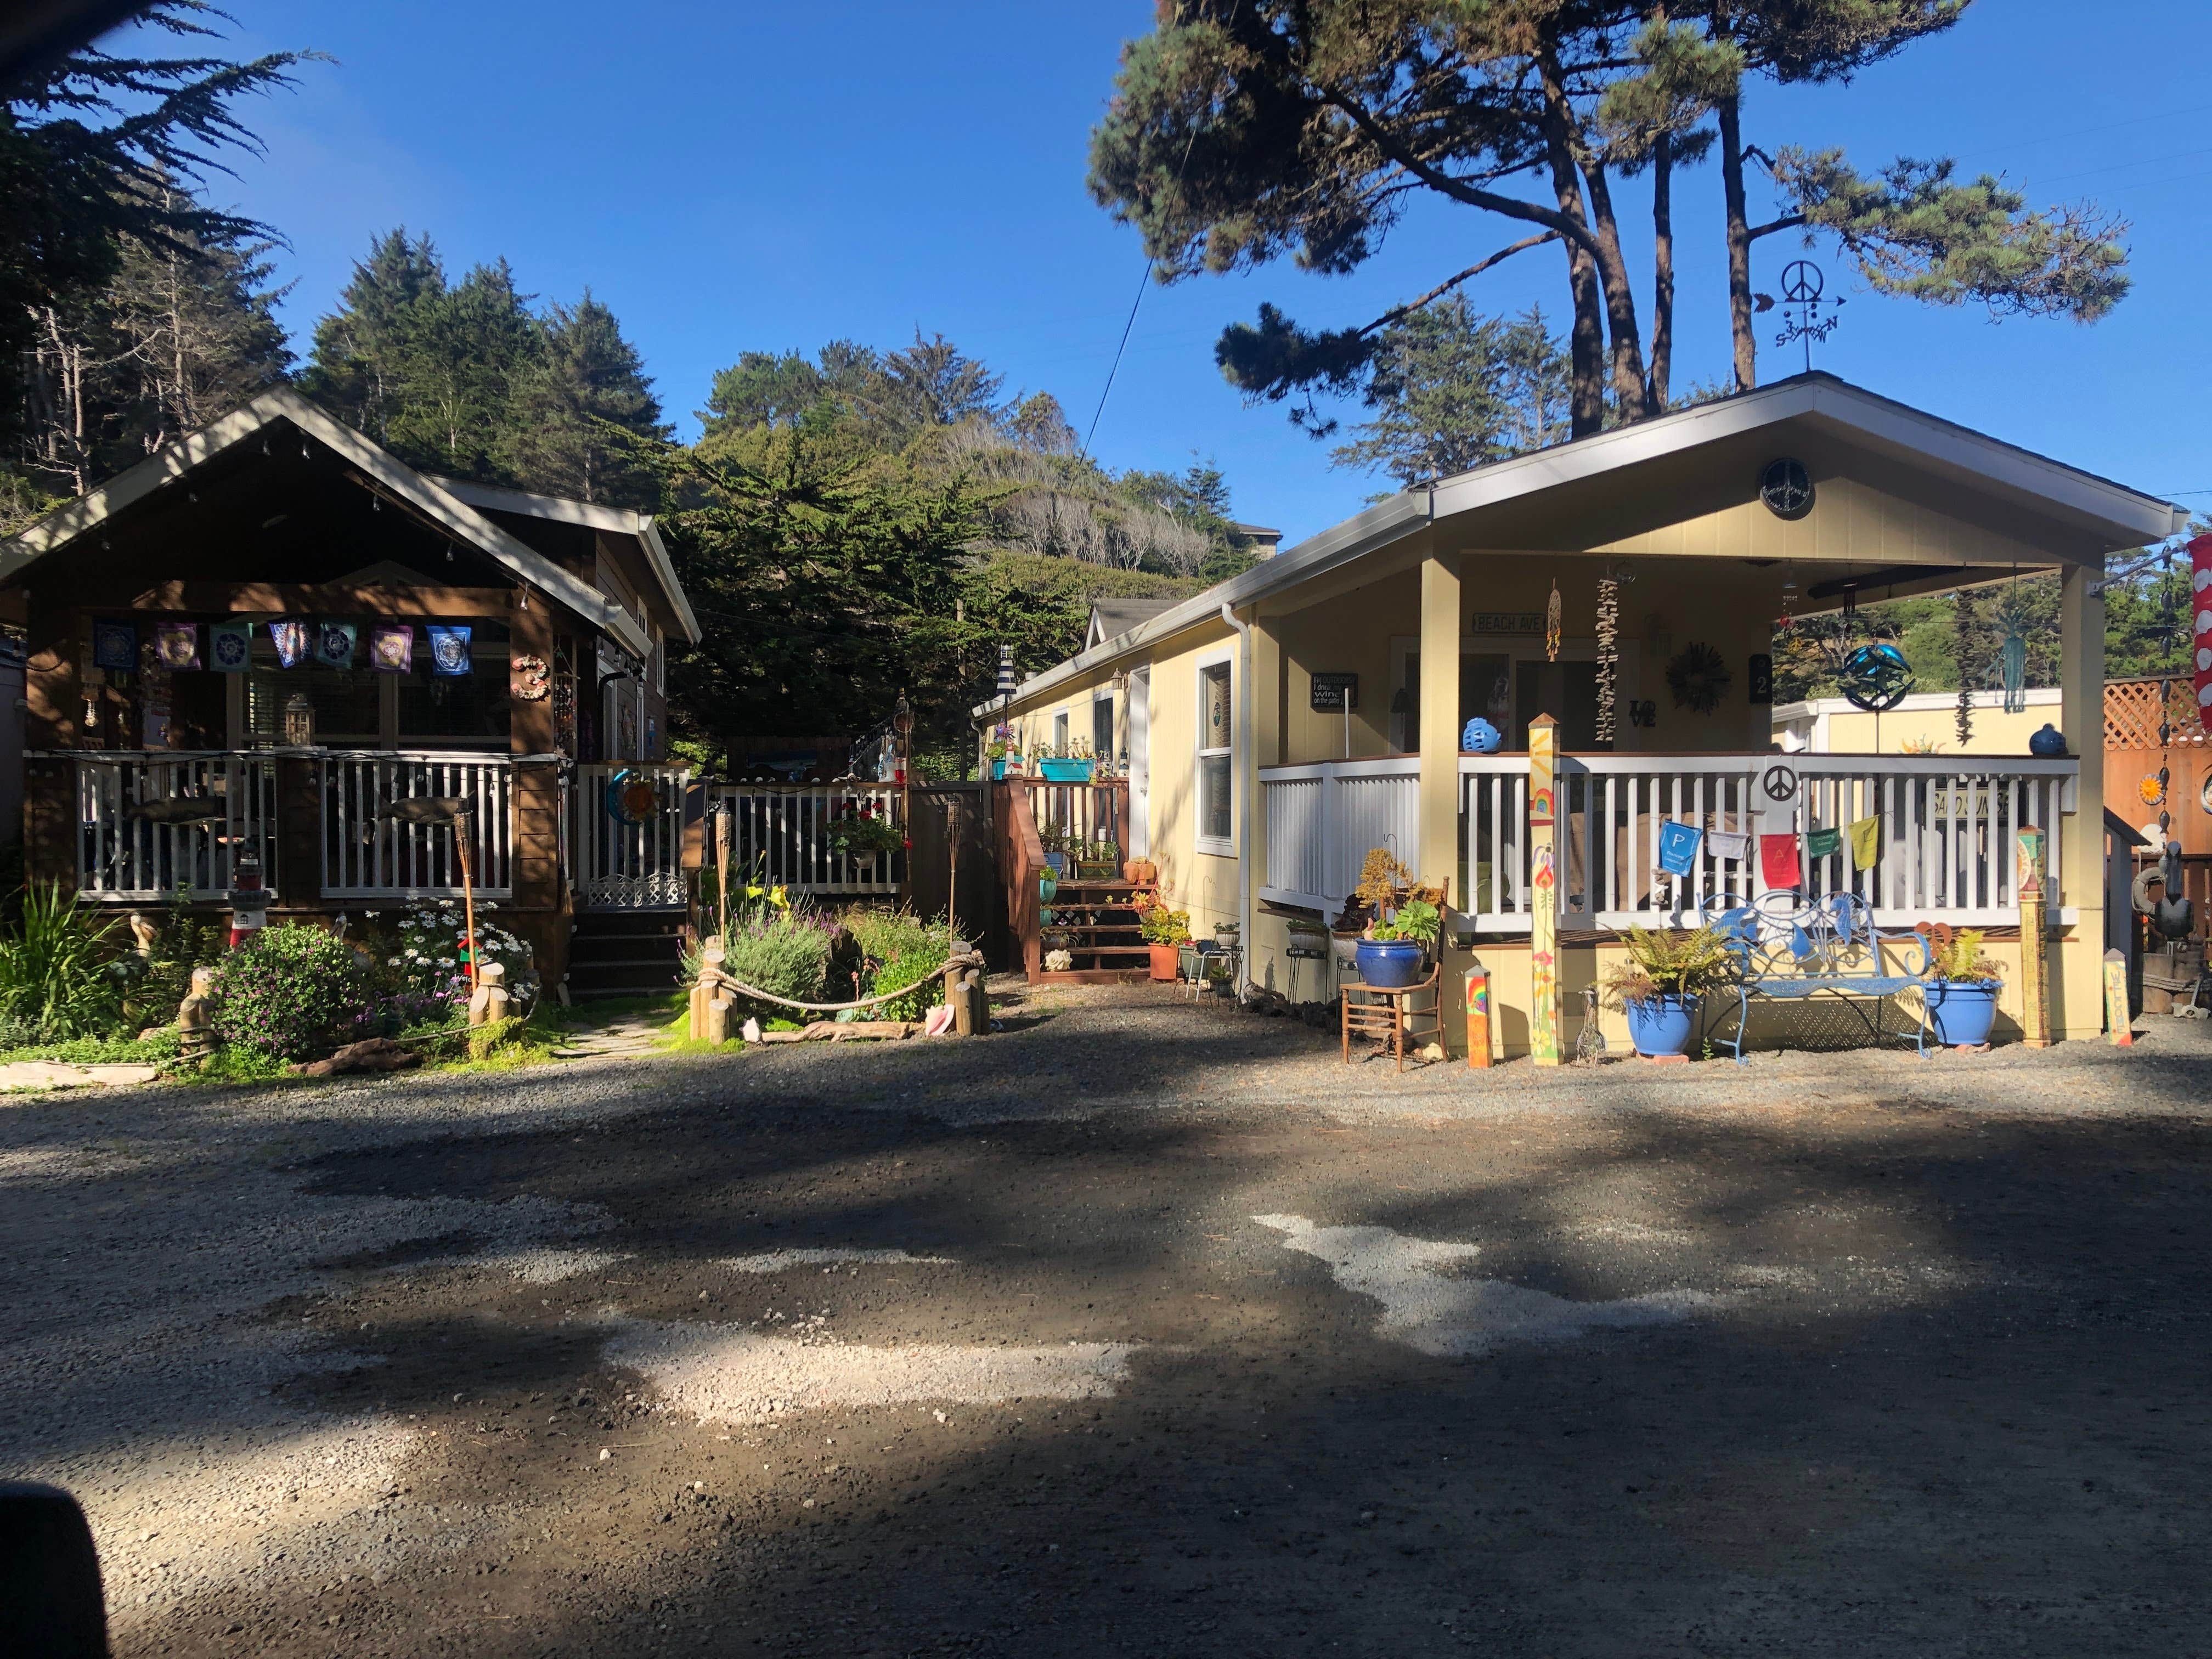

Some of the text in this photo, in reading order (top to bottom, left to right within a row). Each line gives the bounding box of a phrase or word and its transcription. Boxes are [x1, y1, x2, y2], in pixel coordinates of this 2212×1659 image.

[1479, 616, 1540, 630] BEACH AVE
[1757, 676, 1767, 694] 2
[1672, 833, 1685, 848] P
[1773, 848, 1787, 865] A
